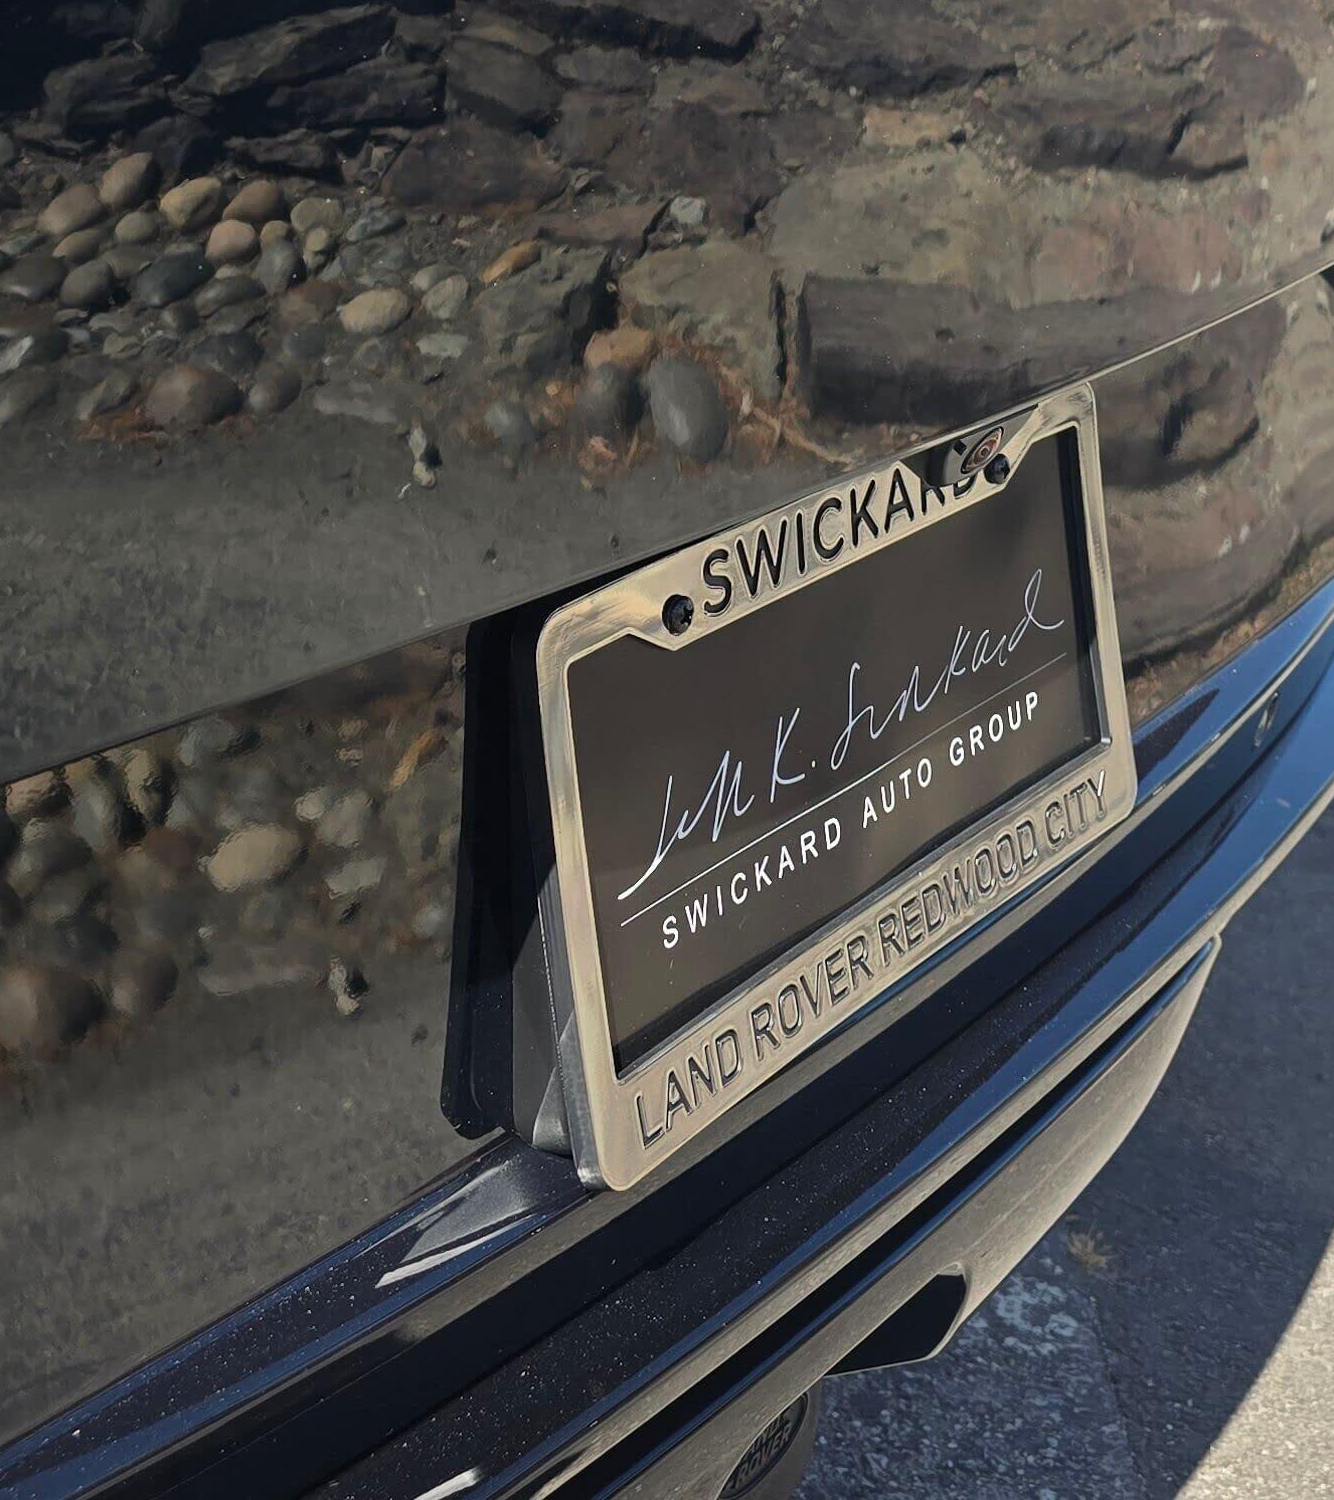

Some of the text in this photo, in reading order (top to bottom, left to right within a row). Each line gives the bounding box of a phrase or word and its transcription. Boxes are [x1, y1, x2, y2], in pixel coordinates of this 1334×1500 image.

[636, 768, 1109, 1150] LAND ROVER REDWOOD CITY
[661, 691, 1038, 949] SWICKARD AUTO GROUP
